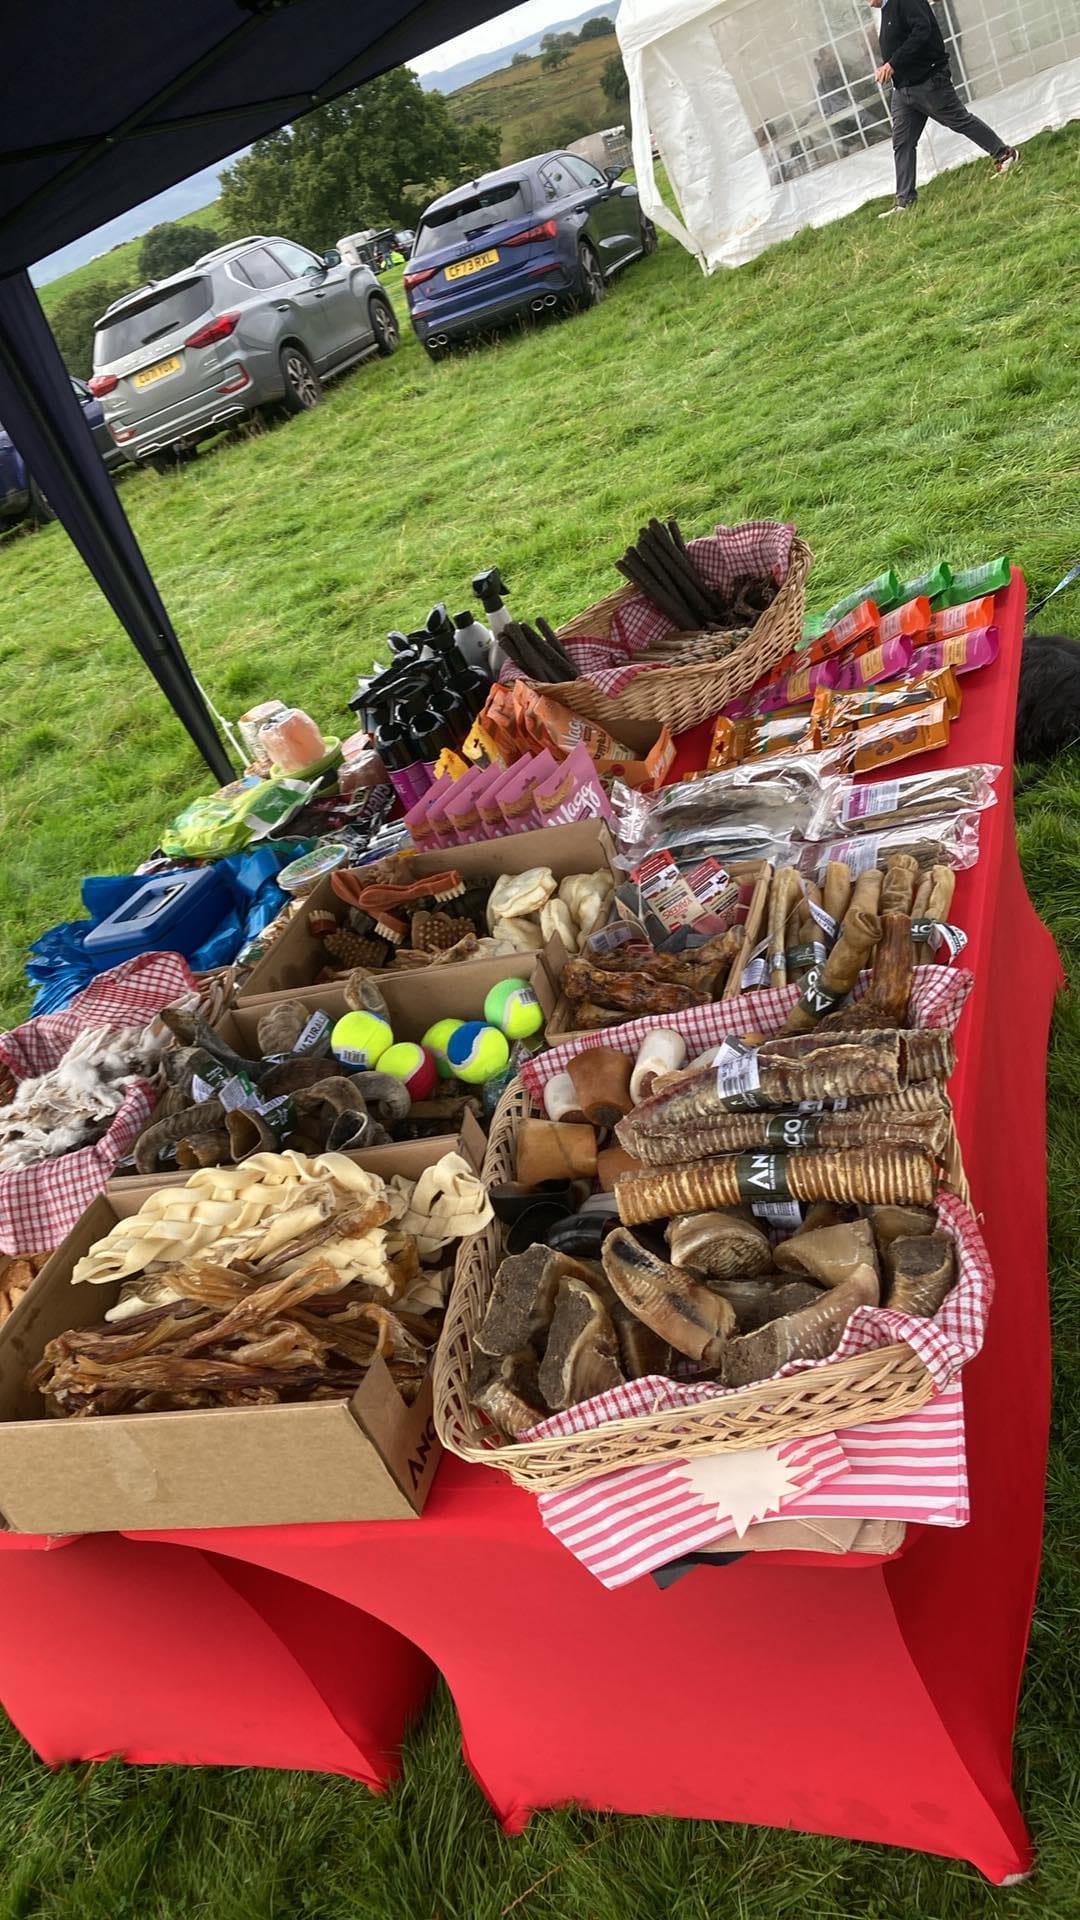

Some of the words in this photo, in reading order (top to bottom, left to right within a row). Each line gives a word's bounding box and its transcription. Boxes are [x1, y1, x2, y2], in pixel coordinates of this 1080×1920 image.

[448, 260, 473, 277] CF73
[474, 255, 495, 268] RXL
[662, 897, 692, 921] YAKERS
